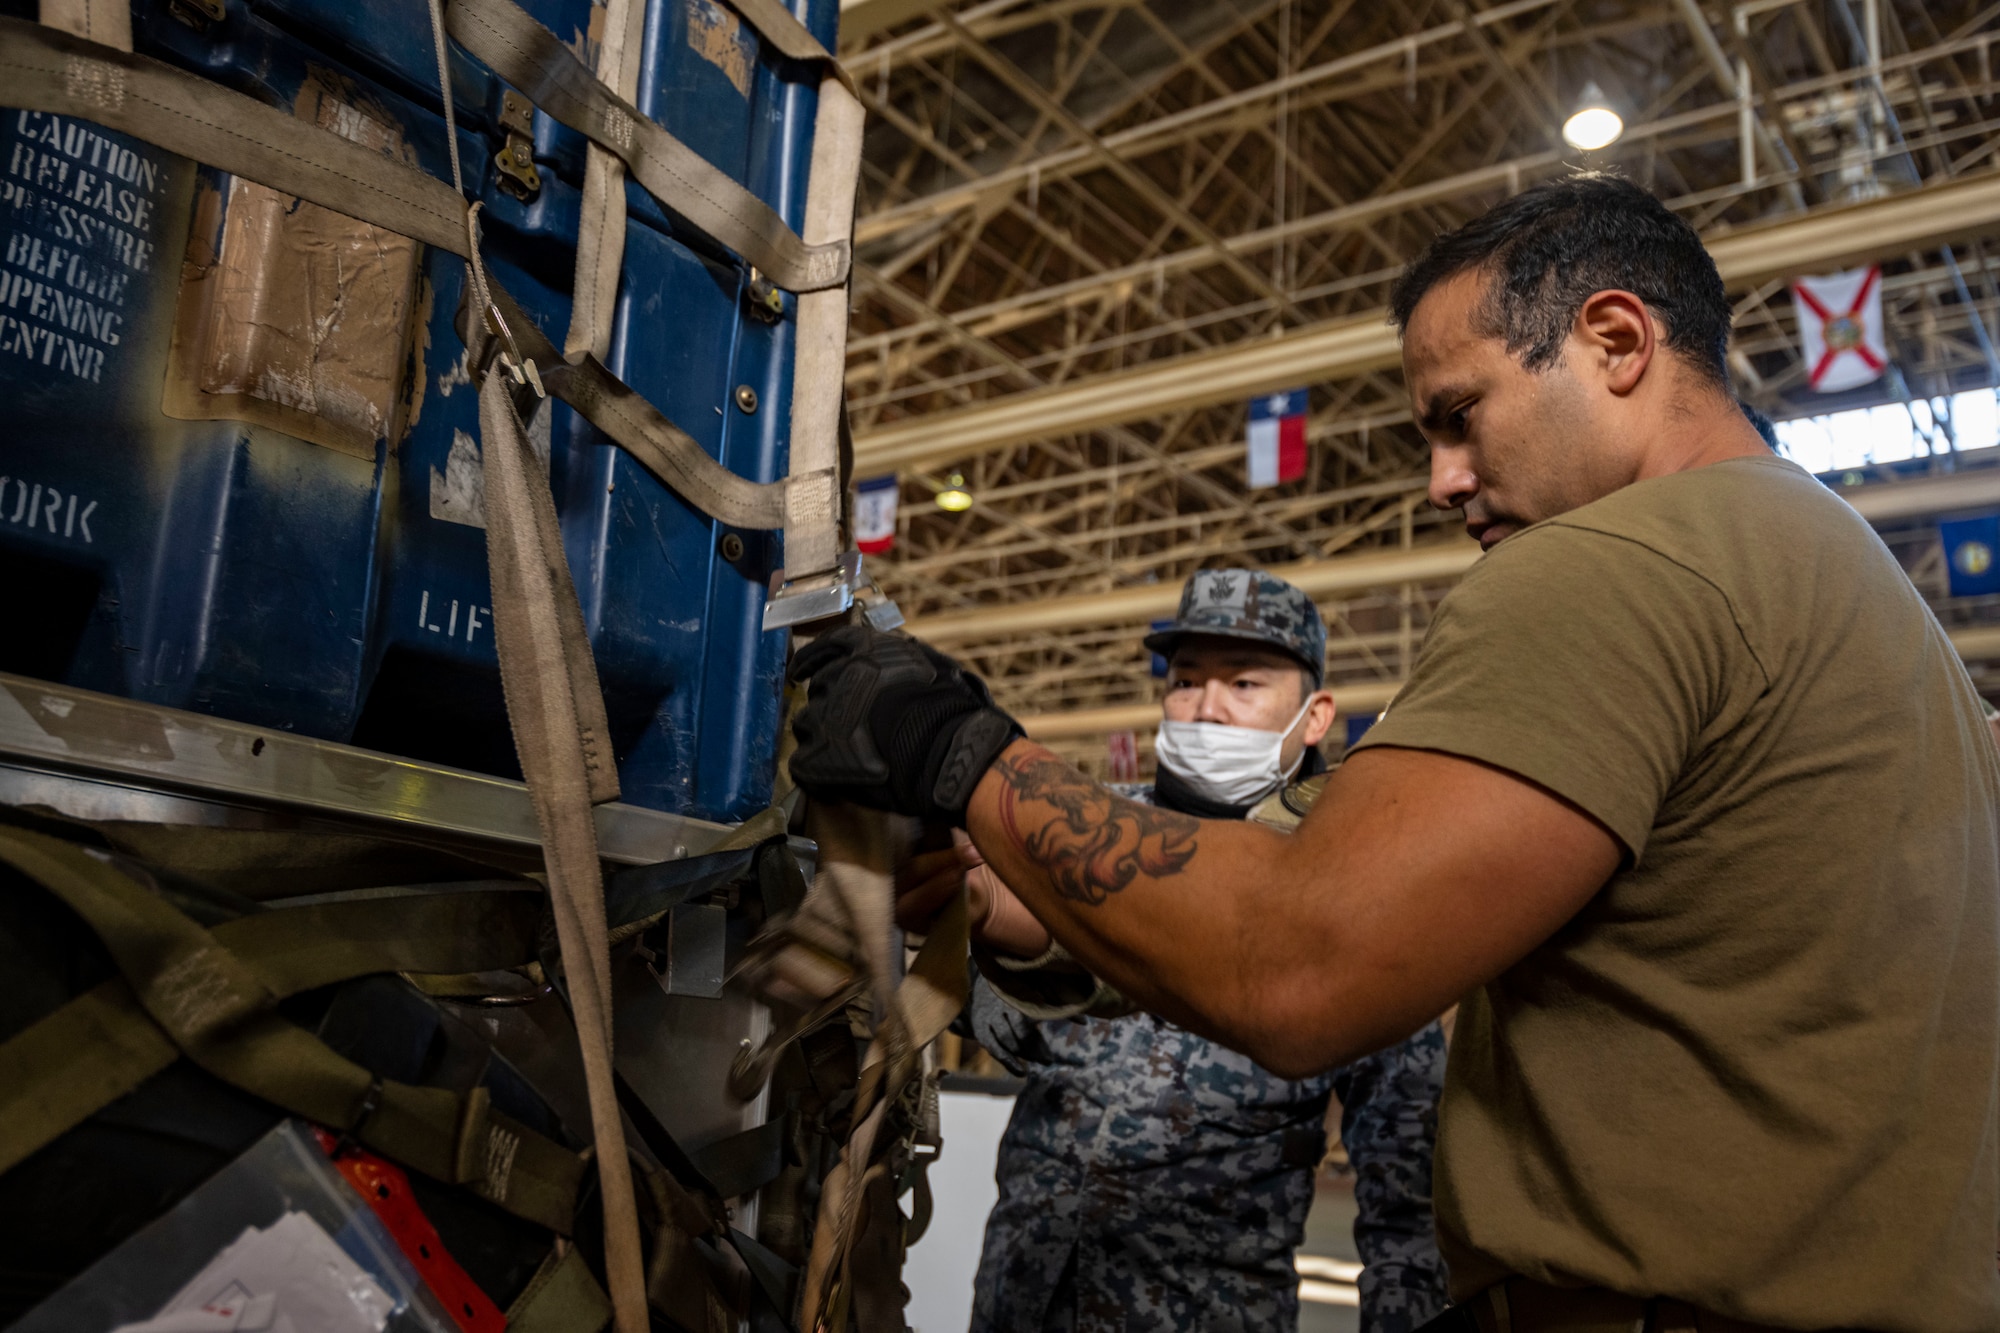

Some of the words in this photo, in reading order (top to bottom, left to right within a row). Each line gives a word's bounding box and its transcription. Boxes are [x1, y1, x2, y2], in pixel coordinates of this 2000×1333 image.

[9, 141, 154, 232] RELEASE
[16, 109, 170, 194] CAUTION:
[6, 231, 129, 306] BEFORE
[0, 314, 105, 384] CNTNR
